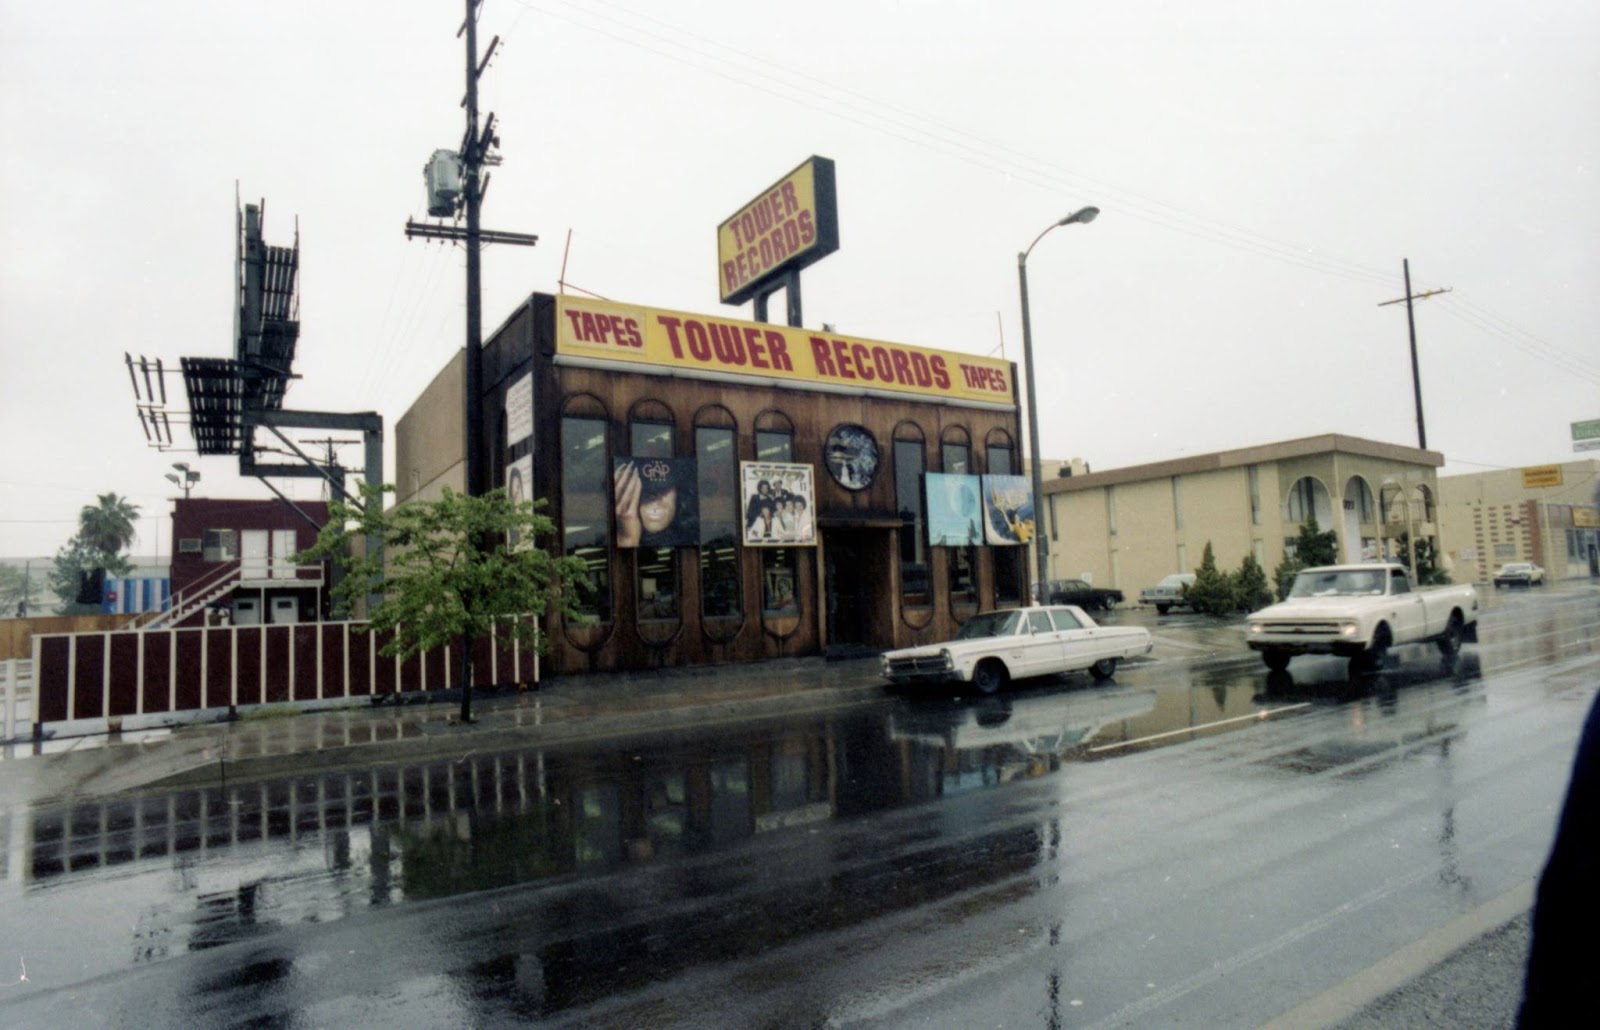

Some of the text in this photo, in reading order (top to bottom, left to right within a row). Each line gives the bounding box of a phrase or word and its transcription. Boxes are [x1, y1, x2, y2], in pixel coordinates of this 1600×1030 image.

[722, 209, 816, 292] RECORDS
[729, 180, 799, 251] TOWER
[564, 309, 643, 348] TAPES
[657, 315, 951, 390] TOWER RECORDS
[959, 363, 1008, 393] TAPES
